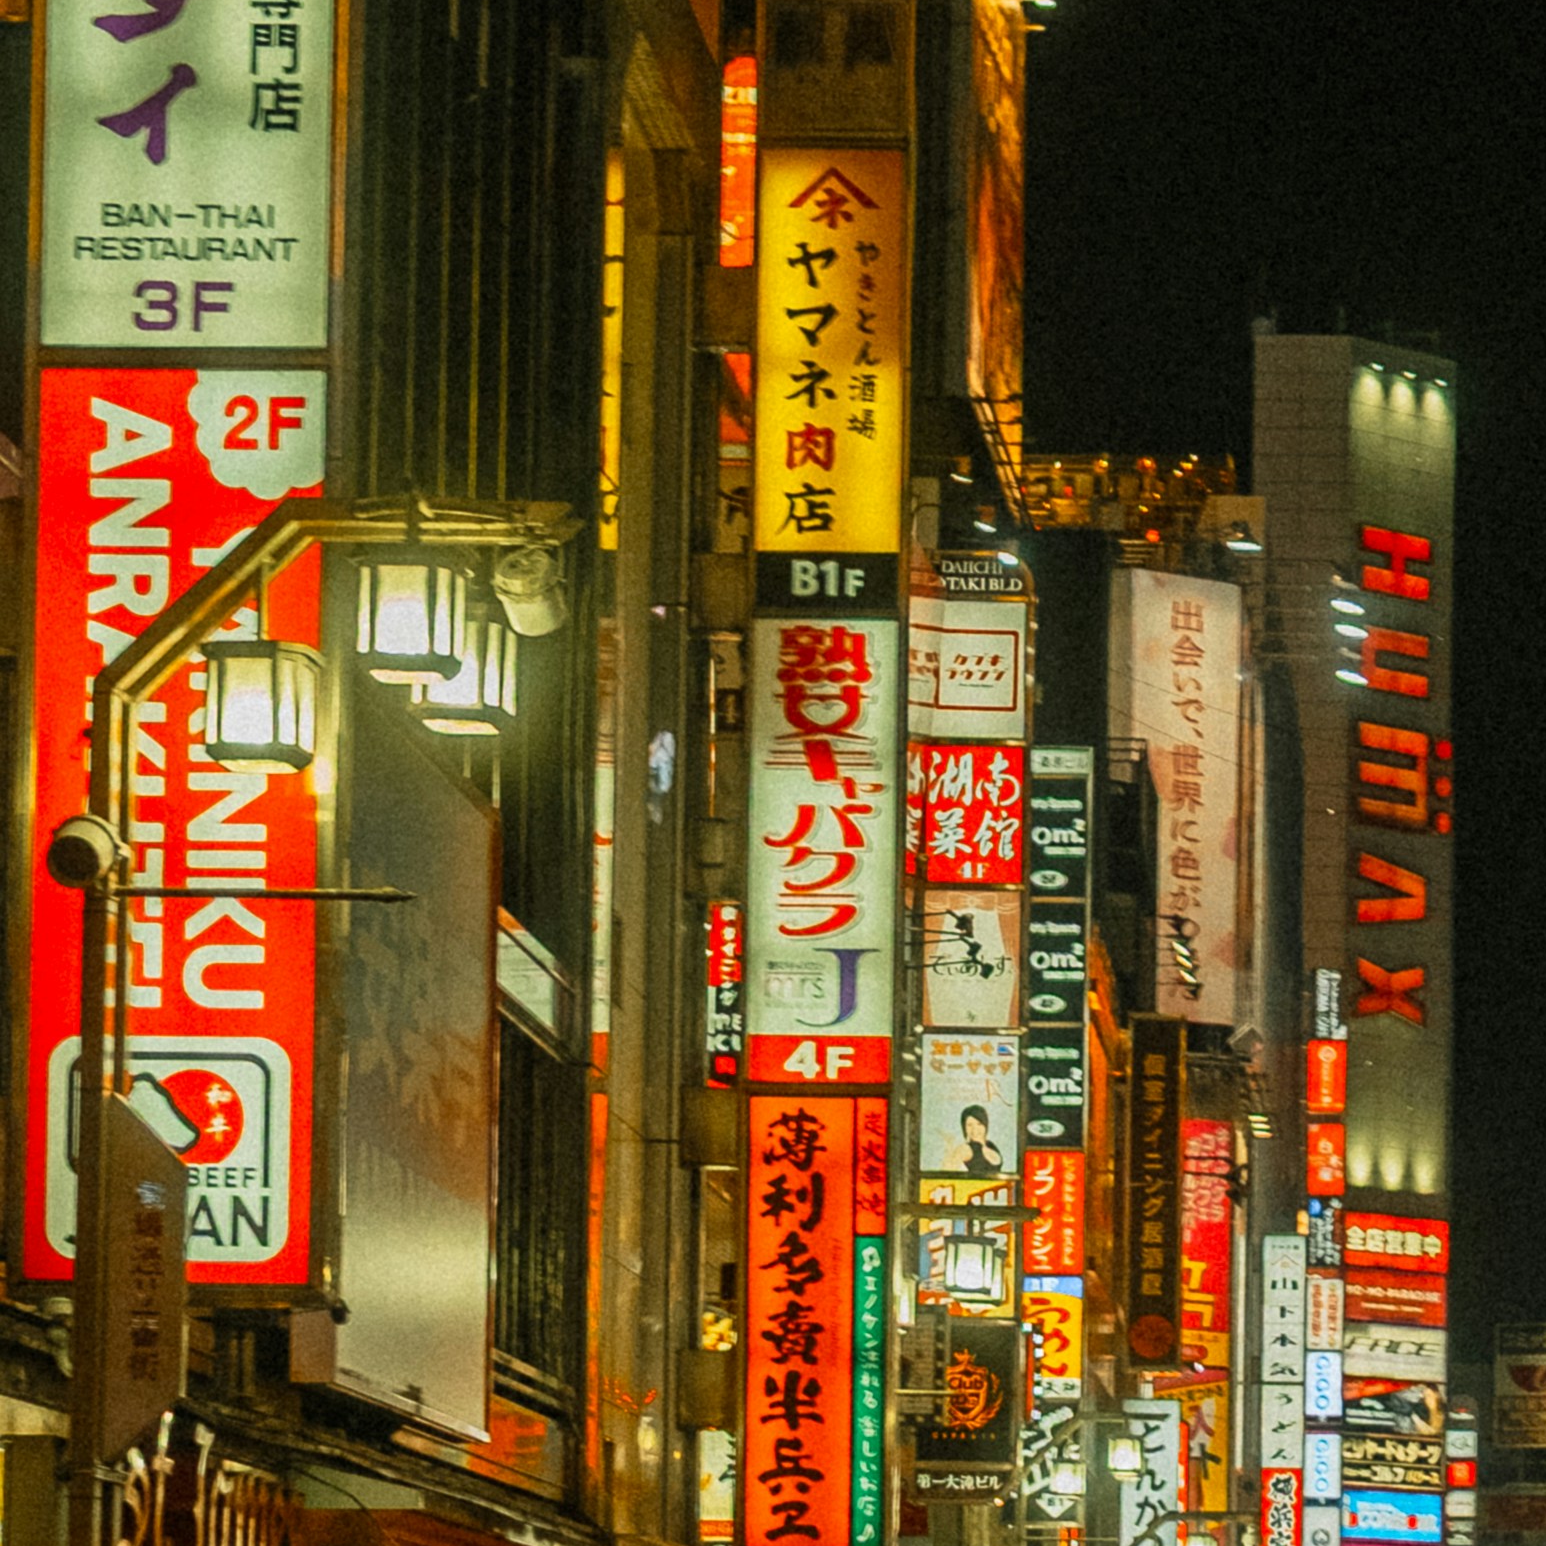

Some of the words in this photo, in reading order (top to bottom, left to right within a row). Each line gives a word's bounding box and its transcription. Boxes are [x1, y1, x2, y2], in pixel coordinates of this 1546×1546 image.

[101, 201, 276, 231] BAN-THAI
[73, 235, 300, 265] RESTAURANT
[130, 279, 234, 333] 3F
[776, 241, 841, 536] ヤマネ肉店
[222, 394, 307, 451] 2F
[790, 558, 866, 599] B1F
[988, 578, 1024, 592] BLD
[762, 625, 886, 938] 熟女キャバクラ
[959, 862, 989, 879] 4F
[811, 947, 881, 1029] J
[782, 1039, 856, 1080] 4F
[187, 1166, 258, 1189] BEEF
[917, 1473, 1003, 1490] 第一大滝ビル
